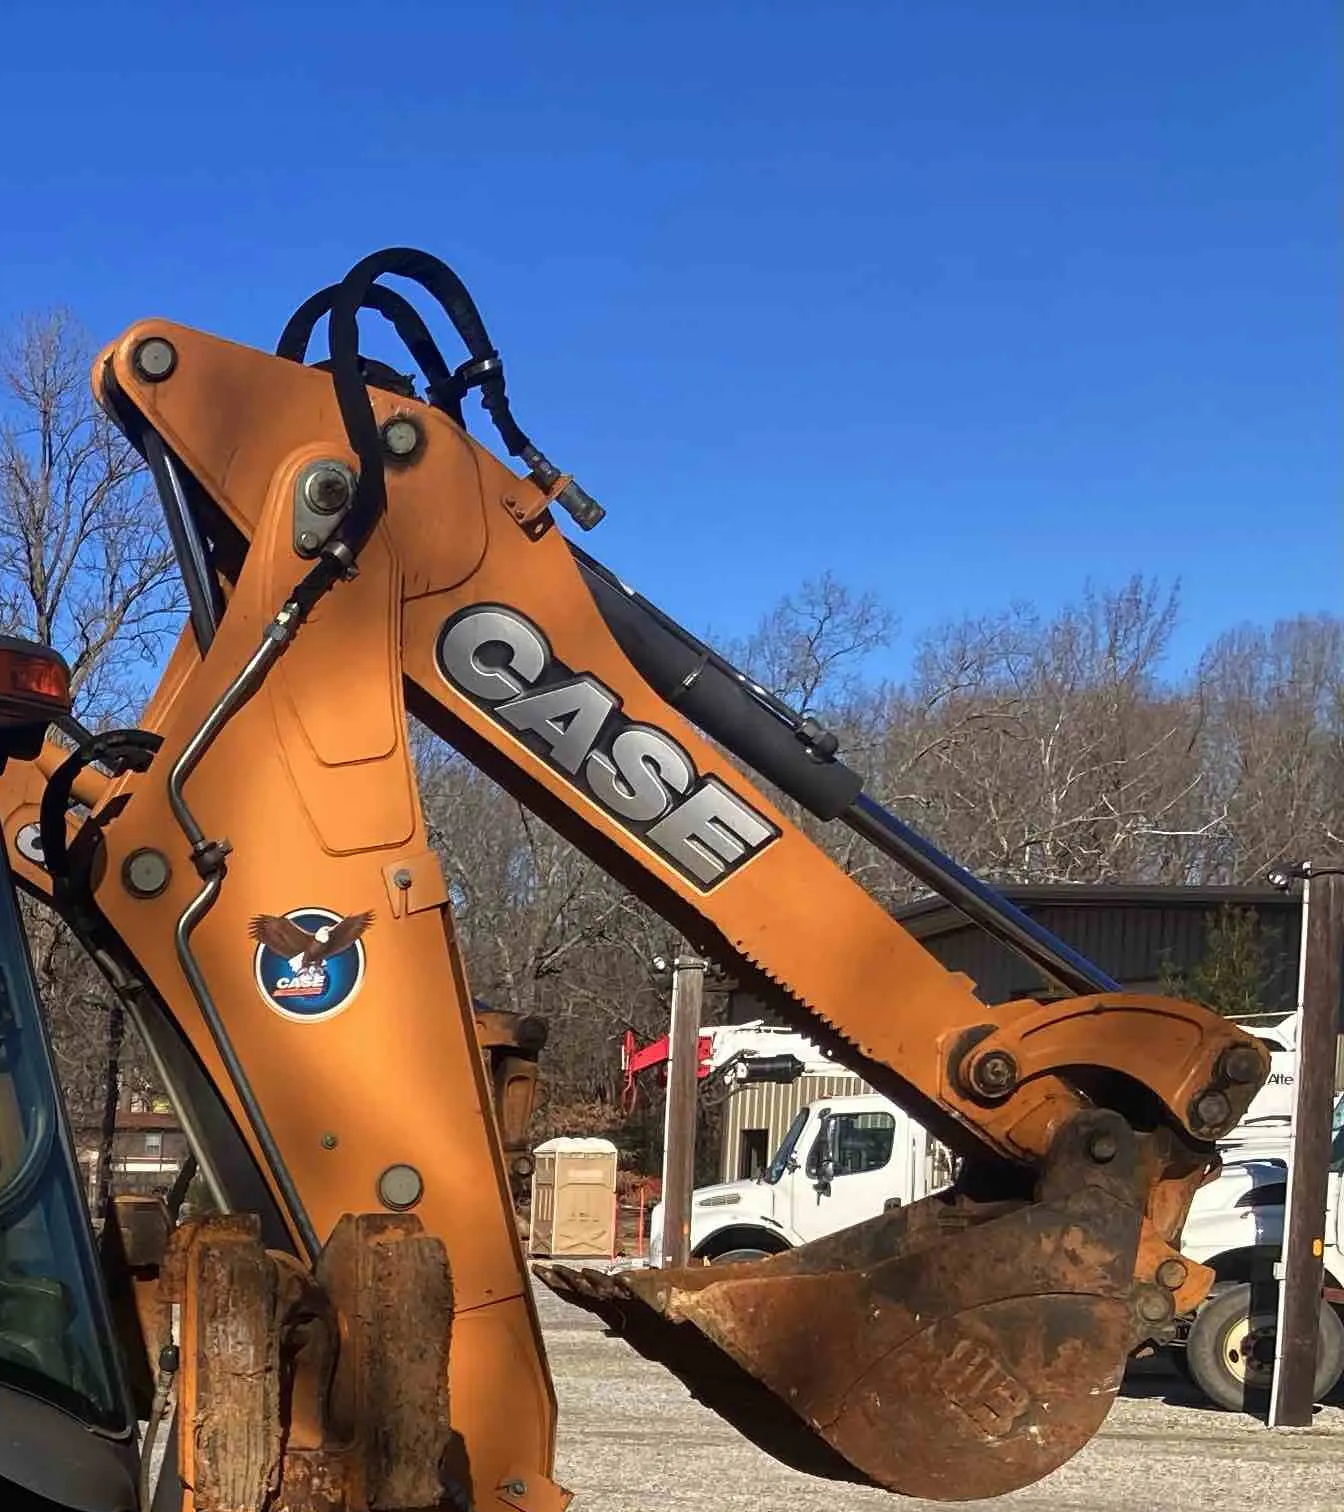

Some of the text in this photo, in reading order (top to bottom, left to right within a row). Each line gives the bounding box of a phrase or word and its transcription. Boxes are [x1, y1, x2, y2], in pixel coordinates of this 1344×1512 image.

[438, 606, 779, 888] CASE
[276, 975, 326, 989] CASE
[1267, 1073, 1295, 1085] Alte
